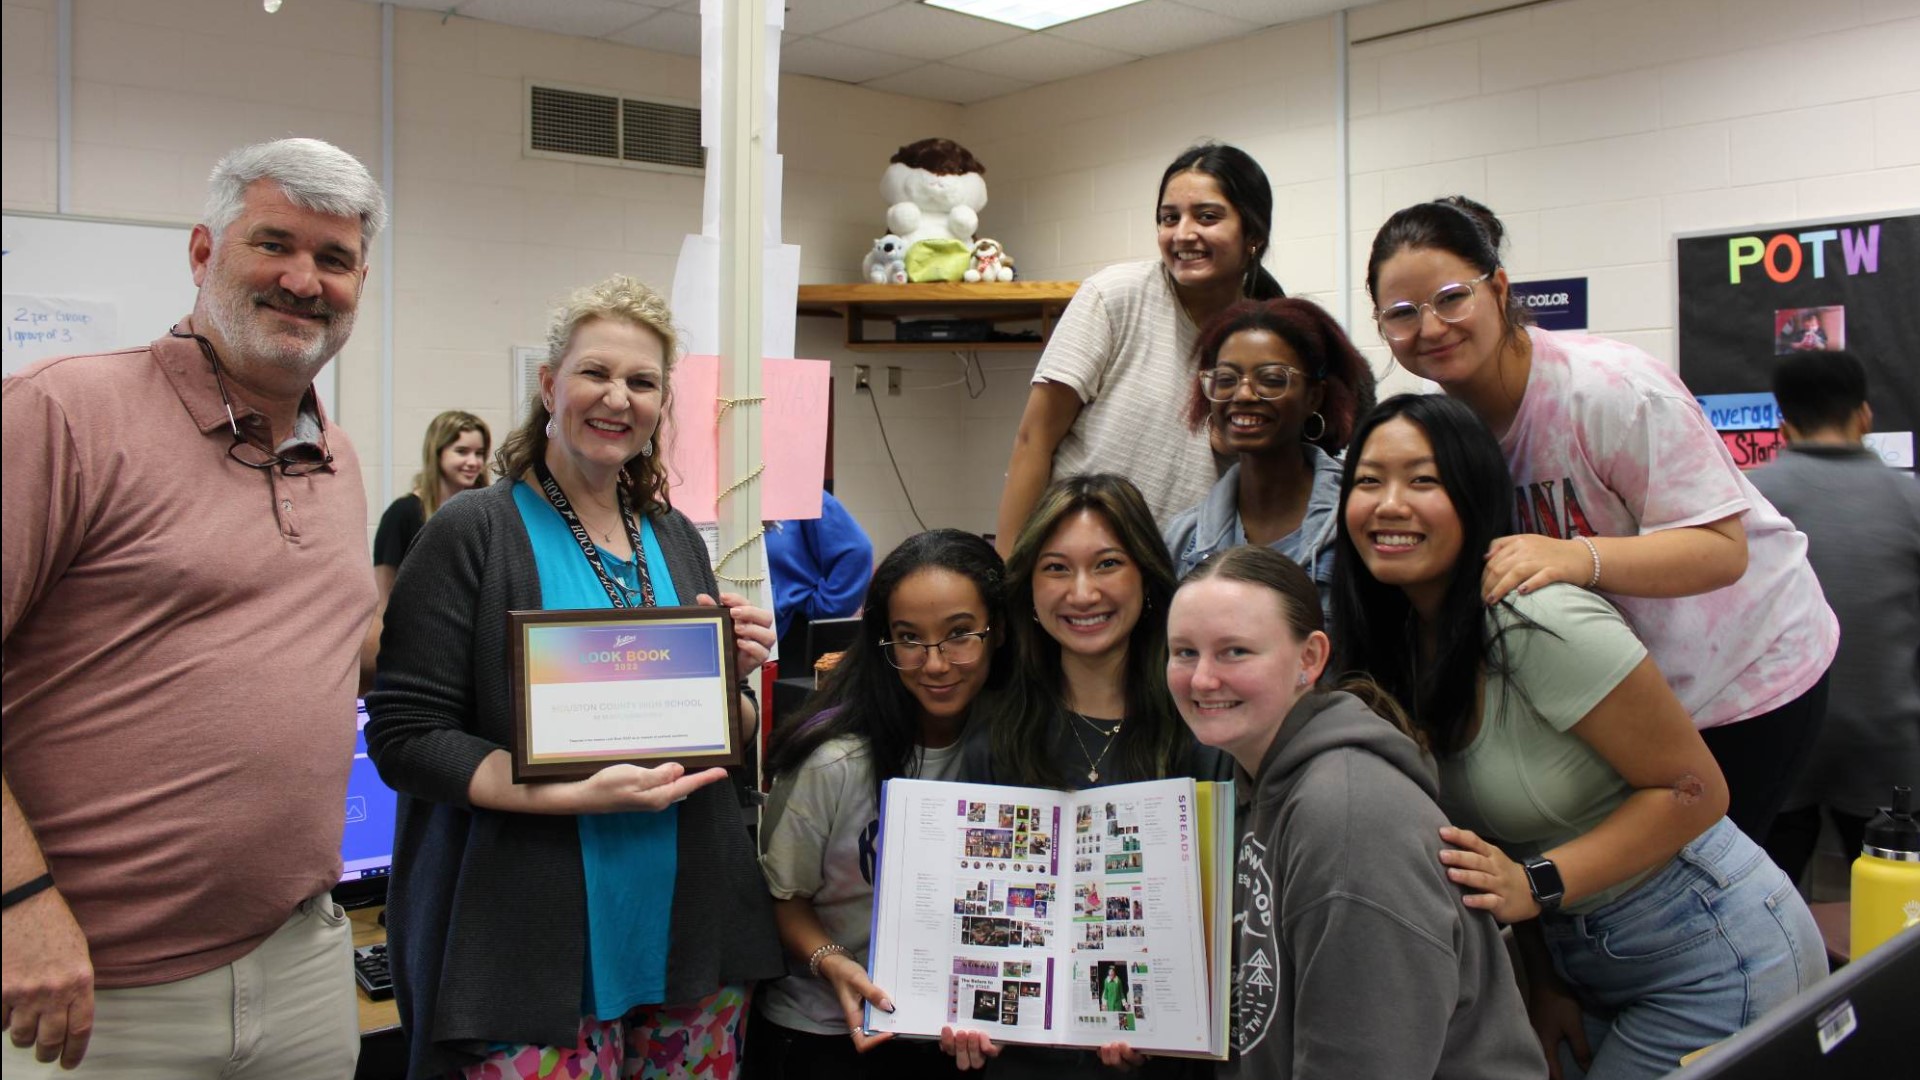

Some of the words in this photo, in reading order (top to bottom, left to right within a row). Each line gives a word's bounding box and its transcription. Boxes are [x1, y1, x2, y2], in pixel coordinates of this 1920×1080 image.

[1728, 224, 1880, 284] POTW
[1527, 293, 1569, 307] COLOR
[14, 307, 29, 321] 2
[61, 328, 72, 342] 3
[543, 478, 567, 508] HOCO
[571, 523, 596, 556] HOCO
[578, 651, 622, 664] LOOK
[626, 649, 671, 662] BOOK
[665, 699, 702, 709] SCHOOL
[1178, 794, 1190, 863] SPREADS
